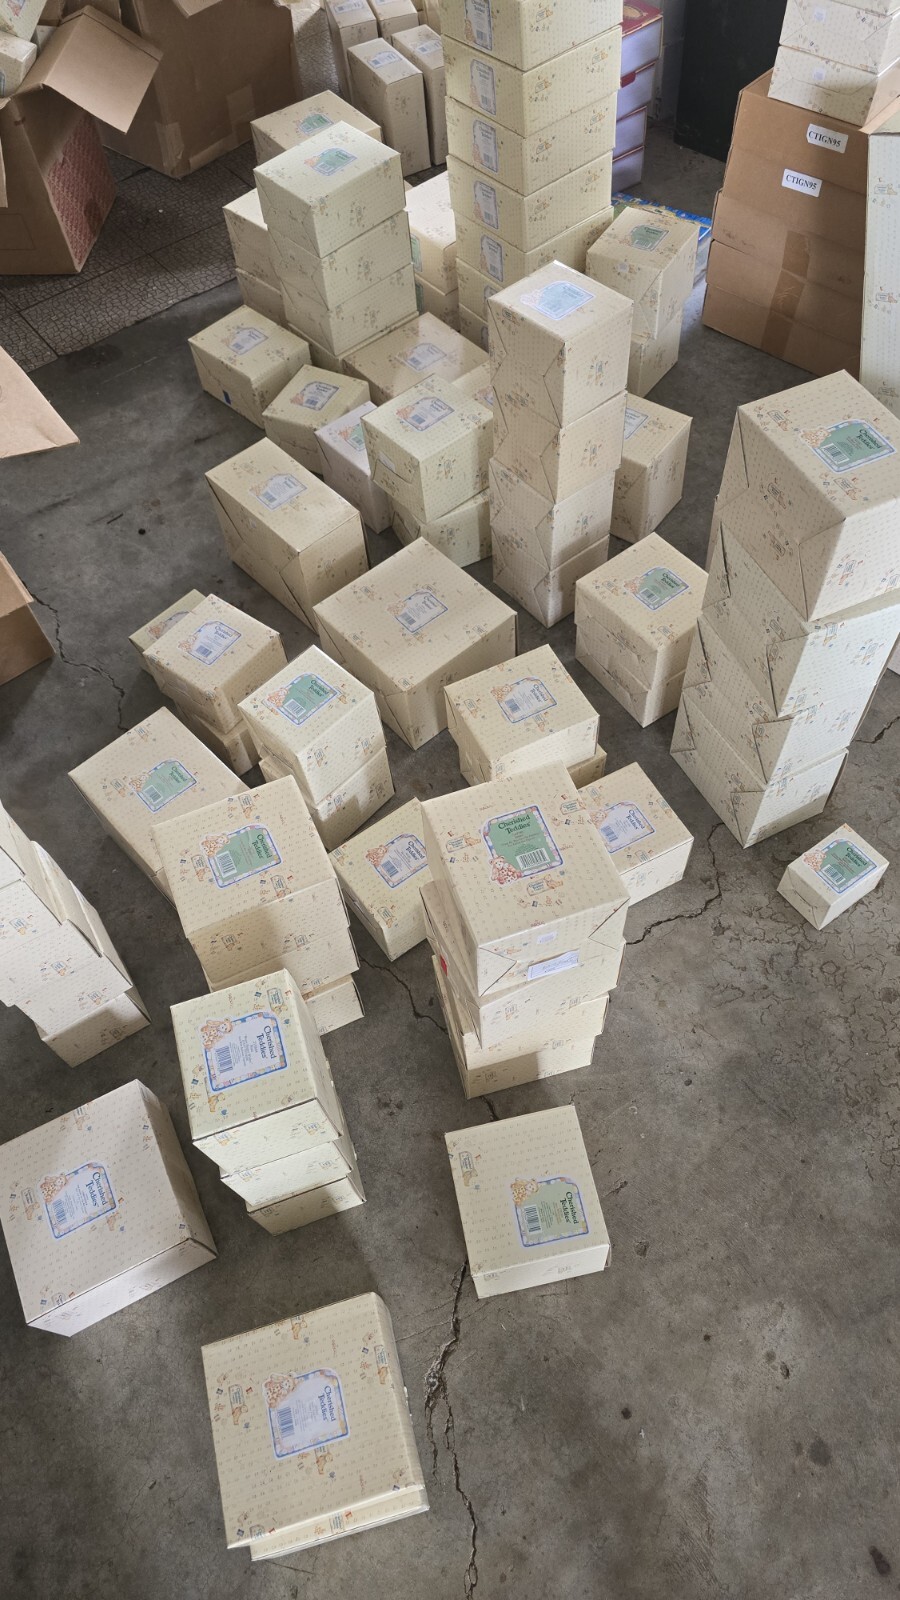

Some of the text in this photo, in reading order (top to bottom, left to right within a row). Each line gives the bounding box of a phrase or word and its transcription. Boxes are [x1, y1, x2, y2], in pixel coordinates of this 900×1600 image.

[808, 130, 841, 147] CTIGN95
[785, 174, 818, 190] CTIGN95
[497, 814, 531, 829] Cherished
[504, 822, 530, 834] Teddies
[256, 1033, 266, 1059] Teddies
[263, 1025, 277, 1059] Cherished
[85, 1180, 98, 1206] Teddies
[92, 1171, 108, 1206] Cherished
[560, 1198, 571, 1223] Teddies
[565, 1191, 579, 1224] Cherished
[317, 1393, 327, 1421] Teddies
[324, 1385, 336, 1422] Cherished
